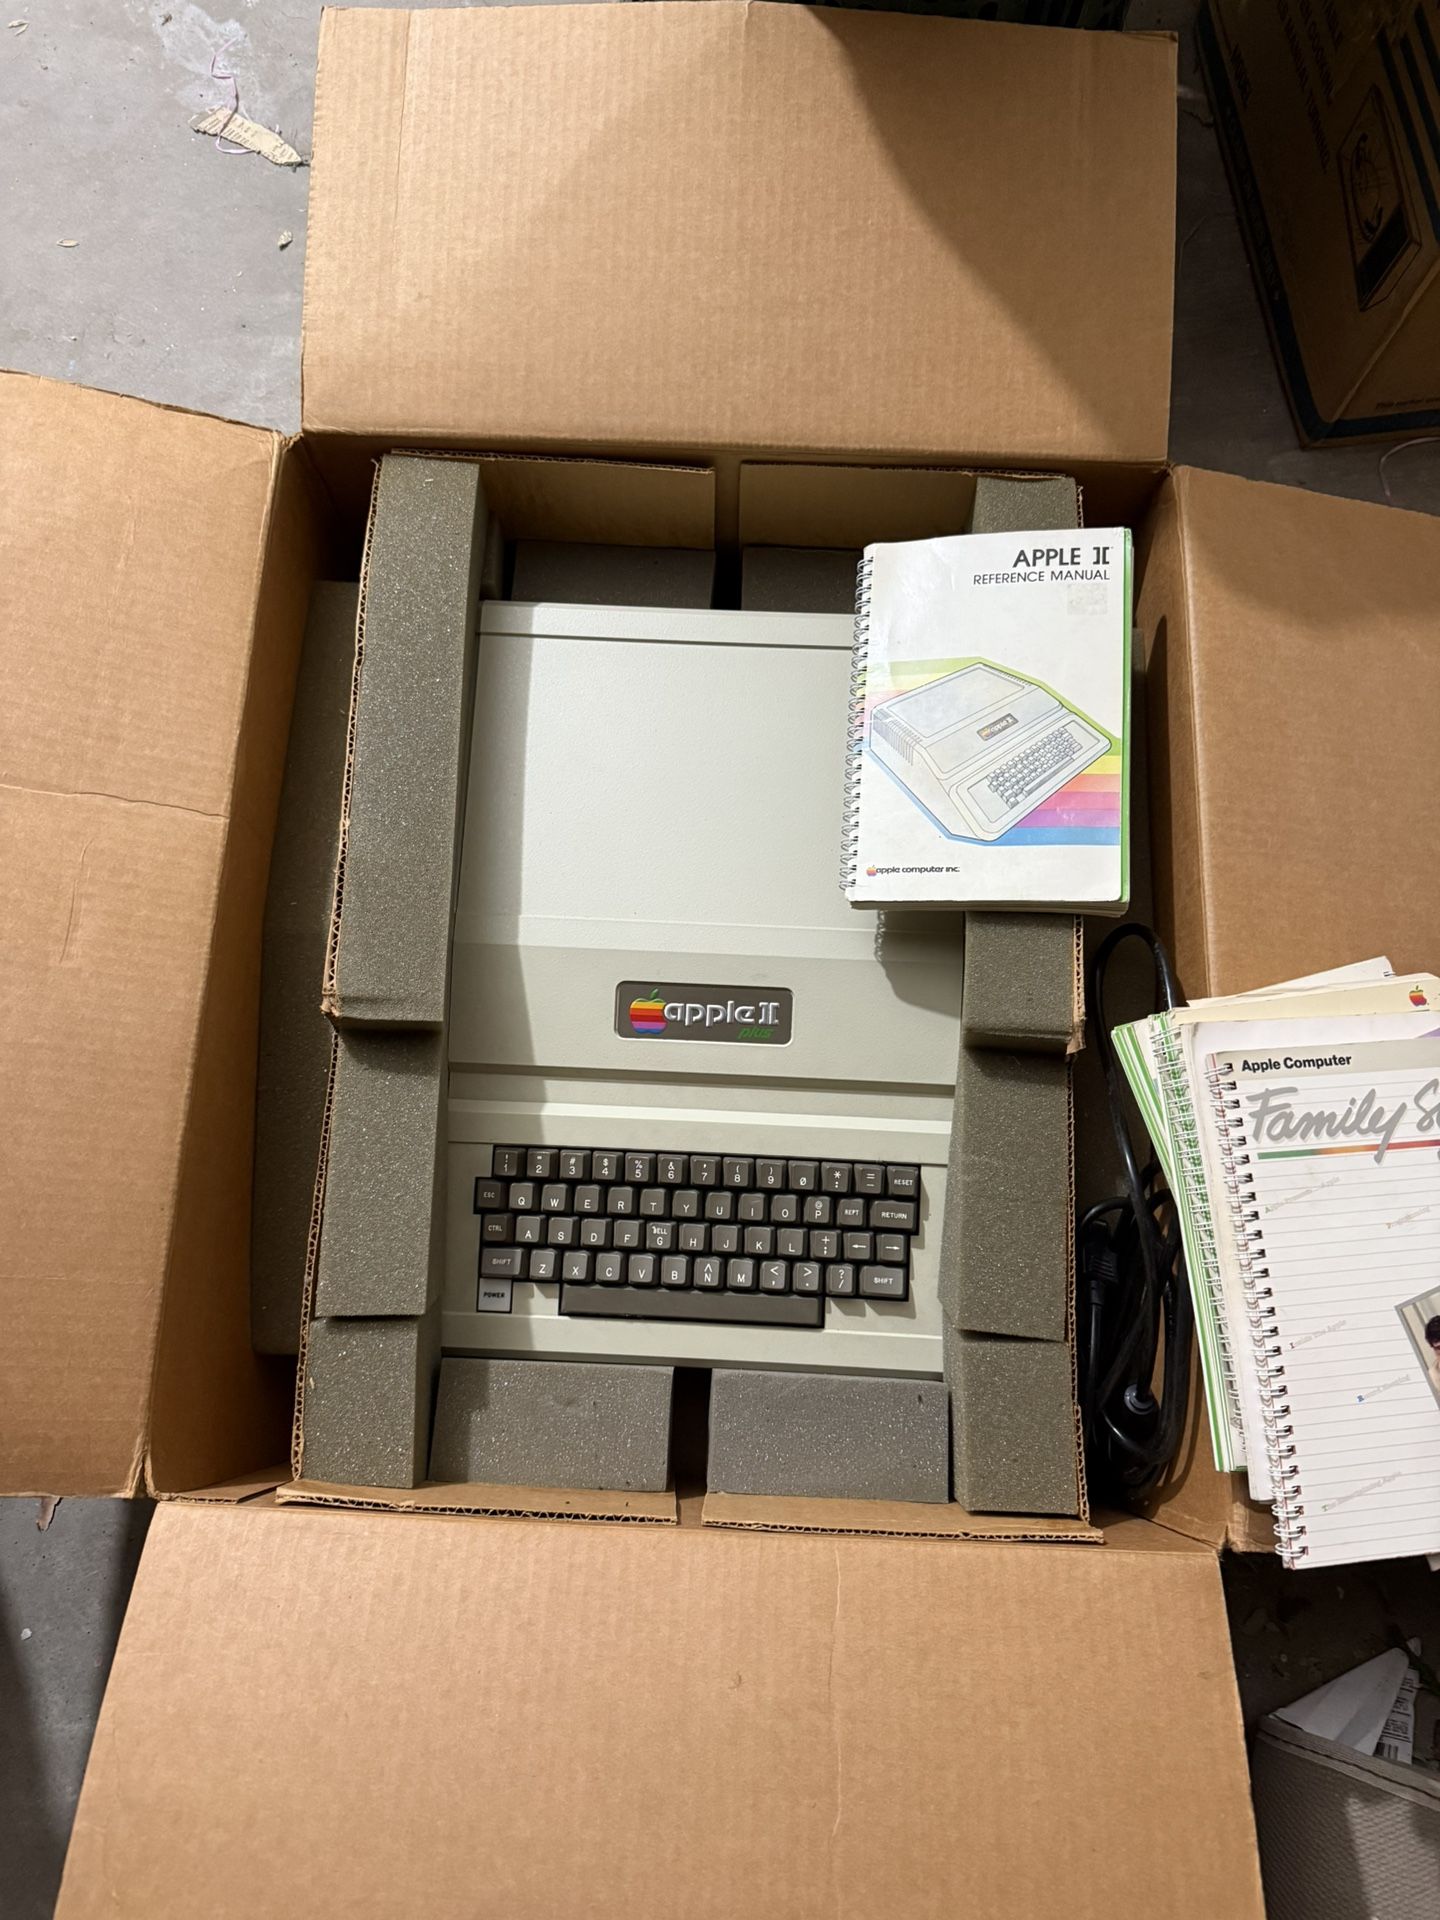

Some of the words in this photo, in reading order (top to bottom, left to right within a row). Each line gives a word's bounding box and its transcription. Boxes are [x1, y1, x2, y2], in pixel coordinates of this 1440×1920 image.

[1012, 547, 1081, 568] APPLE
[973, 571, 1045, 585] REFERENCE
[1050, 569, 1110, 581] MANUAL
[876, 866, 900, 875] apple
[901, 866, 944, 874] computer
[663, 1000, 755, 1027] apple
[737, 1026, 775, 1040] plus
[1241, 1058, 1281, 1073] Apple
[1283, 1055, 1352, 1069] Computer
[1245, 1086, 1408, 1165] Family
[635, 1160, 642, 1169] %
[668, 1162, 675, 1170] &
[536, 1165, 542, 1173] 2
[569, 1166, 575, 1174] 3
[602, 1167, 609, 1175] 4
[635, 1169, 641, 1177] 5
[668, 1171, 674, 1179] 6
[702, 1173, 707, 1181] 7
[734, 1174, 740, 1182] 8
[768, 1176, 774, 1184] 9
[518, 1197, 525, 1206] Q
[550, 1199, 559, 1207] W
[585, 1200, 591, 1208] E
[618, 1201, 624, 1210] R
[651, 1203, 656, 1211] T
[684, 1204, 689, 1213] Y
[716, 1207, 723, 1215] U
[782, 1209, 788, 1217] O
[815, 1210, 821, 1219] P
[525, 1231, 532, 1239] A
[558, 1232, 564, 1240] S
[591, 1233, 597, 1241] D
[624, 1234, 631, 1242] F
[657, 1237, 663, 1245] G
[690, 1238, 697, 1246] H
[723, 1240, 729, 1248] J
[756, 1241, 762, 1249] K
[789, 1243, 795, 1252] L
[540, 1265, 545, 1273] Z
[572, 1267, 579, 1275] X
[606, 1268, 612, 1276] C
[639, 1269, 645, 1278] V
[672, 1271, 678, 1279] B
[704, 1274, 711, 1282] N
[737, 1274, 745, 1282] M
